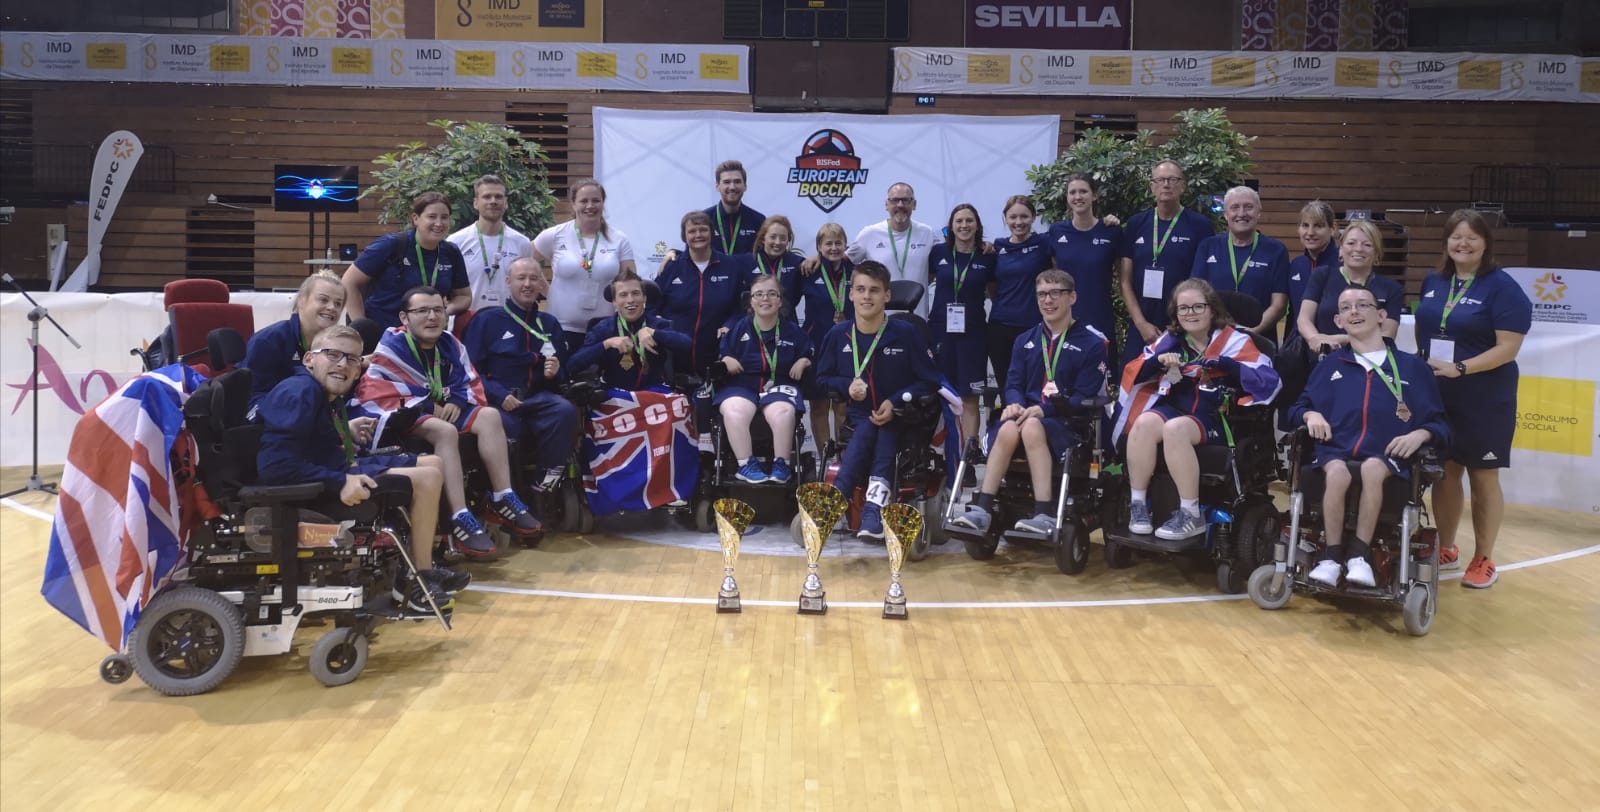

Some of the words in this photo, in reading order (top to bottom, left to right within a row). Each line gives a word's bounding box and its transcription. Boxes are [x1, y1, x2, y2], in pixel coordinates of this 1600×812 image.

[975, 5, 1121, 27] SEVILLA
[47, 42, 72, 53] IMD
[171, 44, 196, 55] IMD
[292, 46, 318, 57] IMD
[416, 49, 441, 60] IMD
[538, 50, 563, 61] IMD
[661, 53, 686, 64] IMD
[926, 54, 953, 65] IMD
[1047, 56, 1074, 67] IMD
[1170, 57, 1197, 69] IMD
[1293, 57, 1320, 68] IMD
[1417, 61, 1445, 72] IMD
[1538, 61, 1566, 73] IMD
[788, 168, 868, 183] EUROPEAN
[93, 160, 120, 222] FEDPC
[799, 183, 853, 197] BOCCIA
[1534, 303, 1571, 311] EDPC
[1524, 412, 1579, 425] CONSUMO
[1523, 422, 1559, 433] SOCIAL
